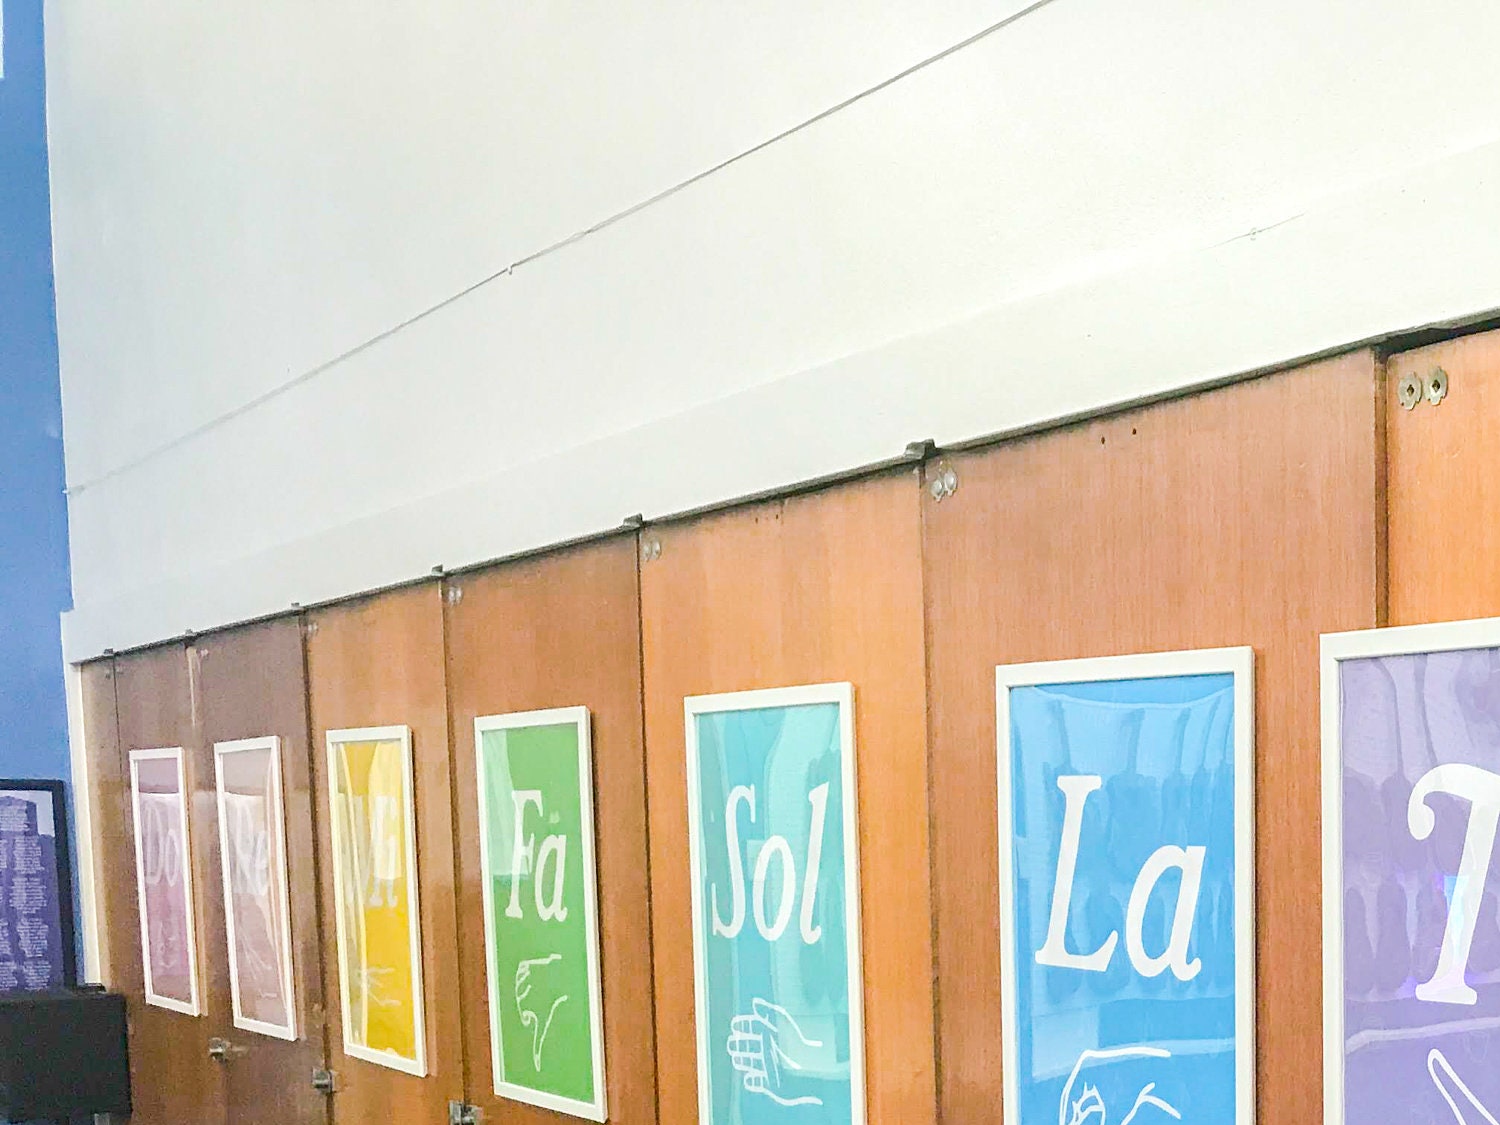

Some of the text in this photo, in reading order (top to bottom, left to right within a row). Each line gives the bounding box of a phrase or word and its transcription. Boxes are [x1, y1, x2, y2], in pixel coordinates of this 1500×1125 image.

[505, 789, 568, 922] Fa
[710, 780, 830, 945] Sol
[1034, 774, 1207, 982] La
